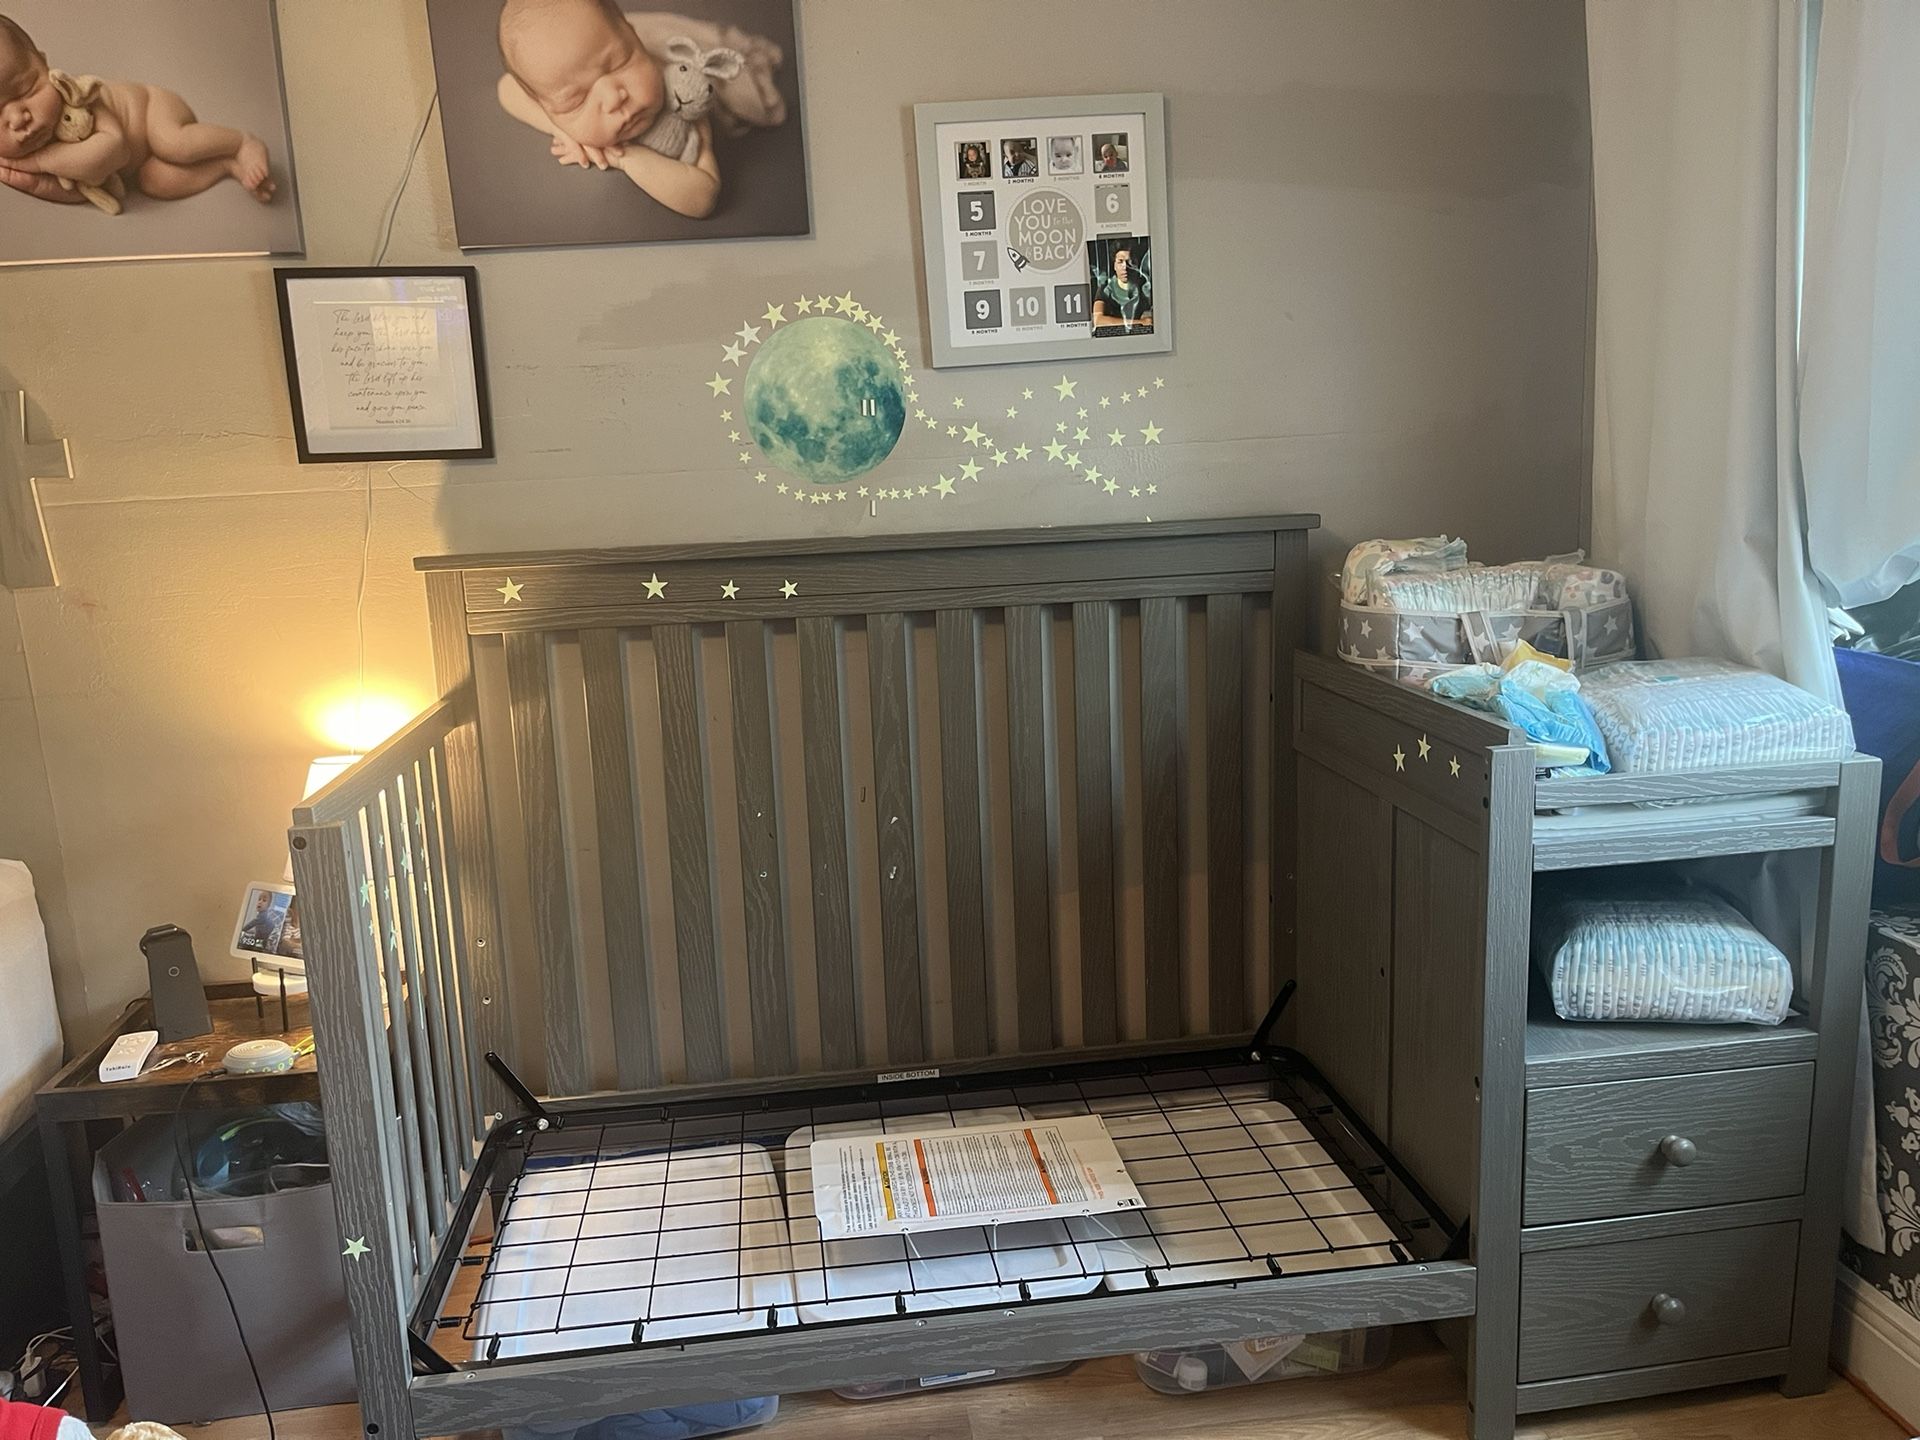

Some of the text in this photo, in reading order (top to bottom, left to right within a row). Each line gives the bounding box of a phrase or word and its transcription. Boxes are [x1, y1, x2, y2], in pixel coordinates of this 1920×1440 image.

[970, 200, 984, 222] 5
[1023, 198, 1067, 214] LOVE
[1106, 193, 1120, 214] 6
[1014, 214, 1050, 231] YOU
[1019, 228, 1076, 246] MOON
[973, 251, 986, 270] 7
[1033, 244, 1074, 261] BACK
[976, 300, 990, 320] 9
[1016, 296, 1039, 317] 10
[1064, 294, 1082, 314] 11
[333, 309, 350, 324] The
[333, 328, 354, 340] keep
[361, 342, 375, 354] to
[340, 356, 356, 366] and
[356, 358, 366, 368] be
[364, 360, 396, 373] gracious
[397, 356, 412, 368] to
[383, 372, 398, 388] lift
[399, 375, 409, 384] up
[348, 386, 428, 402] countenance upon you
[356, 400, 372, 411] and
[388, 405, 405, 416] you
[906, 1070, 936, 1078] BOTTOM
